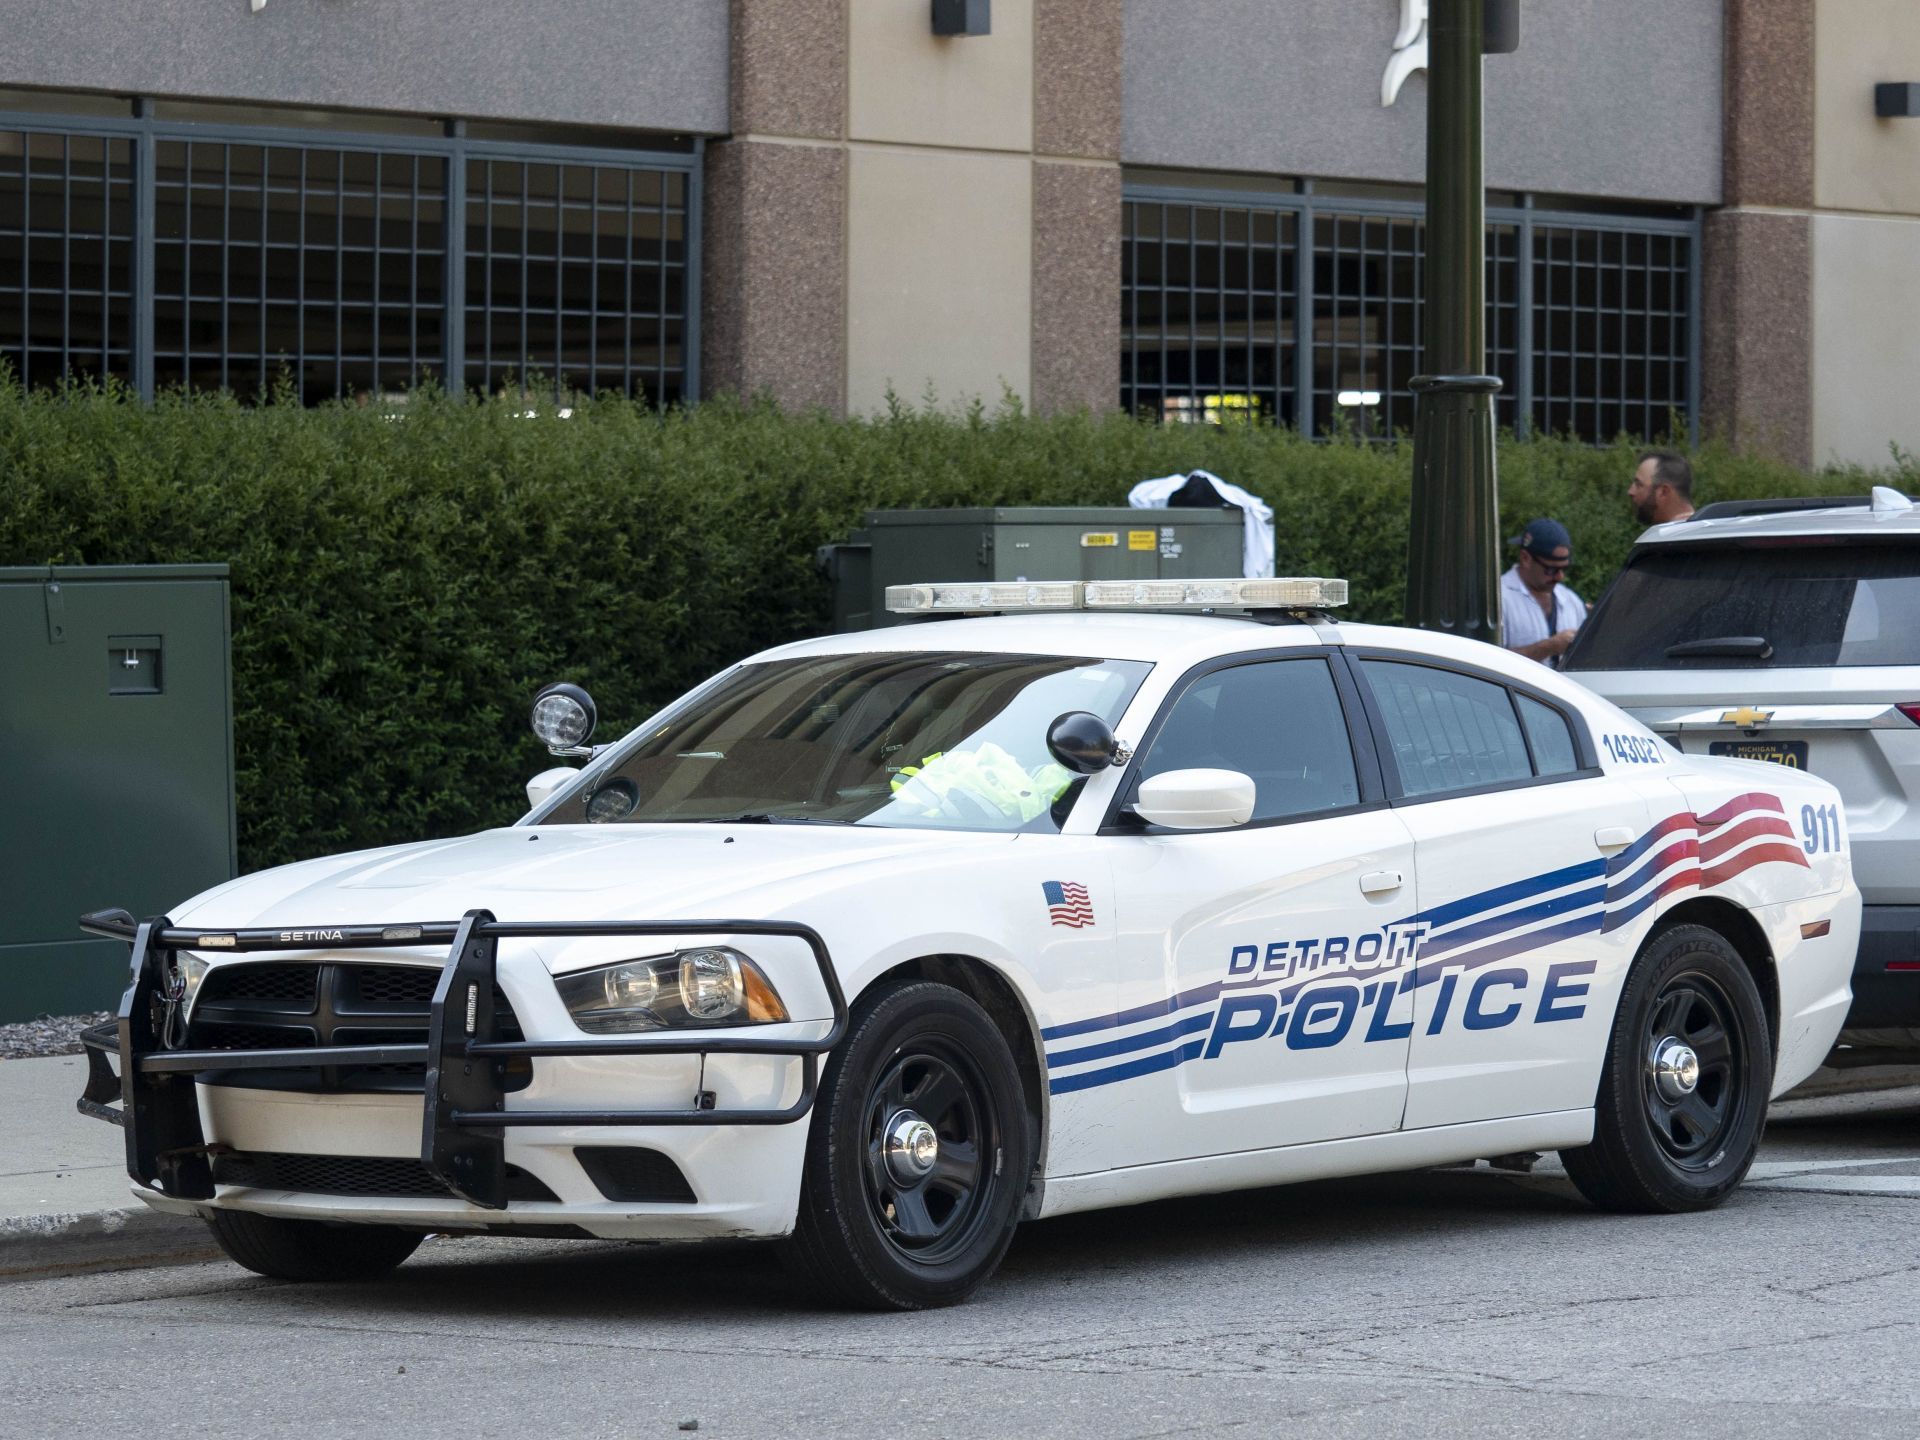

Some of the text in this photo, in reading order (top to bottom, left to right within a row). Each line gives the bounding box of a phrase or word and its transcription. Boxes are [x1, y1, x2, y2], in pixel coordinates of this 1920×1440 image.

[1603, 734, 1666, 764] 143027
[1738, 745, 1778, 753] MICHIGAN
[1801, 803, 1841, 855] 911
[280, 930, 343, 942] SETINA
[1228, 928, 1426, 976] DETROIT
[1203, 959, 1598, 1060] POLICE
